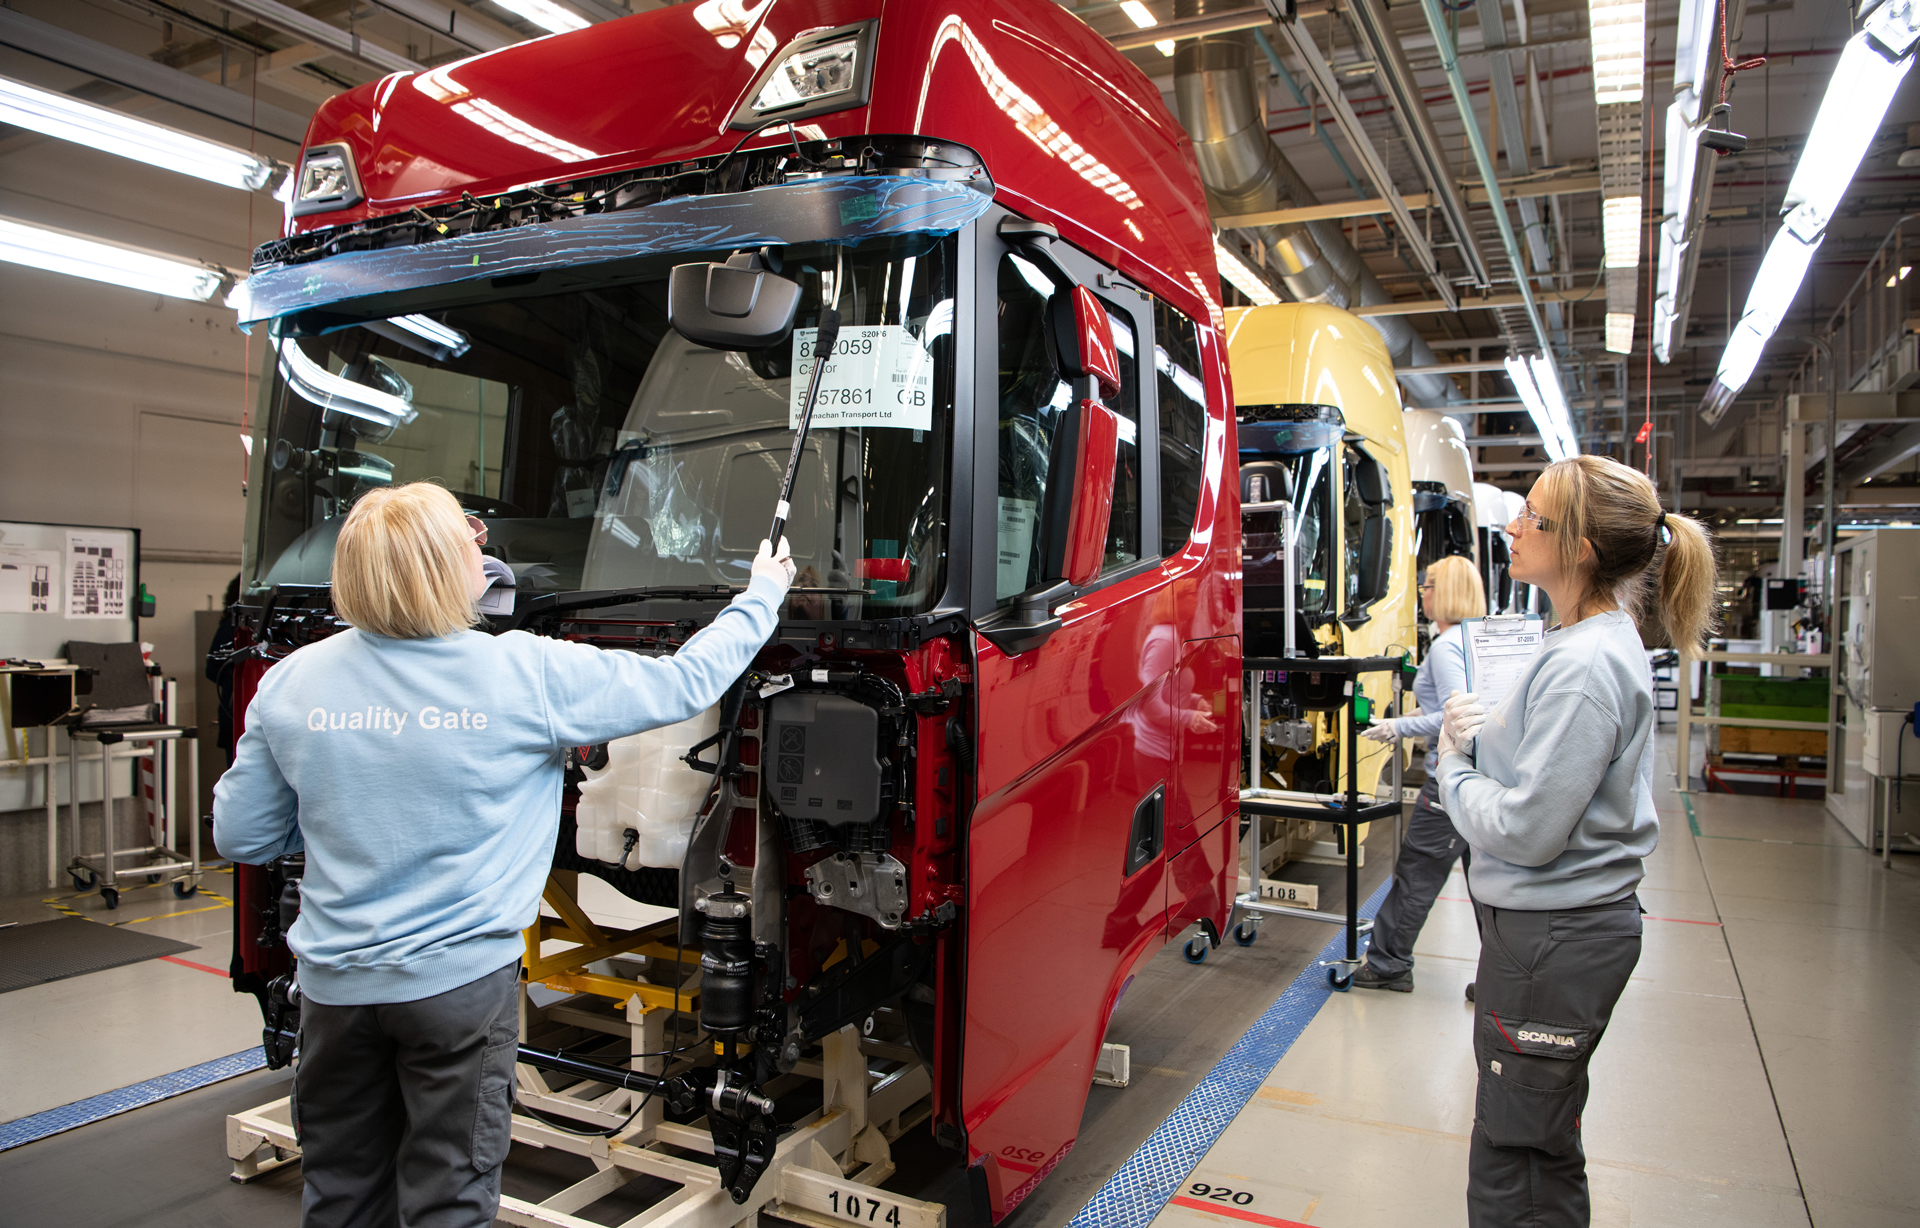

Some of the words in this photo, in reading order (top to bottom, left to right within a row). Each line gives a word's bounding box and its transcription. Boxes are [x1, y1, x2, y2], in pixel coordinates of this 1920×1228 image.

[799, 363, 838, 375] Cator
[797, 388, 872, 407] 557861
[307, 706, 409, 735] Quality
[418, 706, 488, 730] Gate
[1517, 1030, 1577, 1048] SCANIA
[1188, 1183, 1254, 1205] 920
[829, 1190, 901, 1228] 1074
